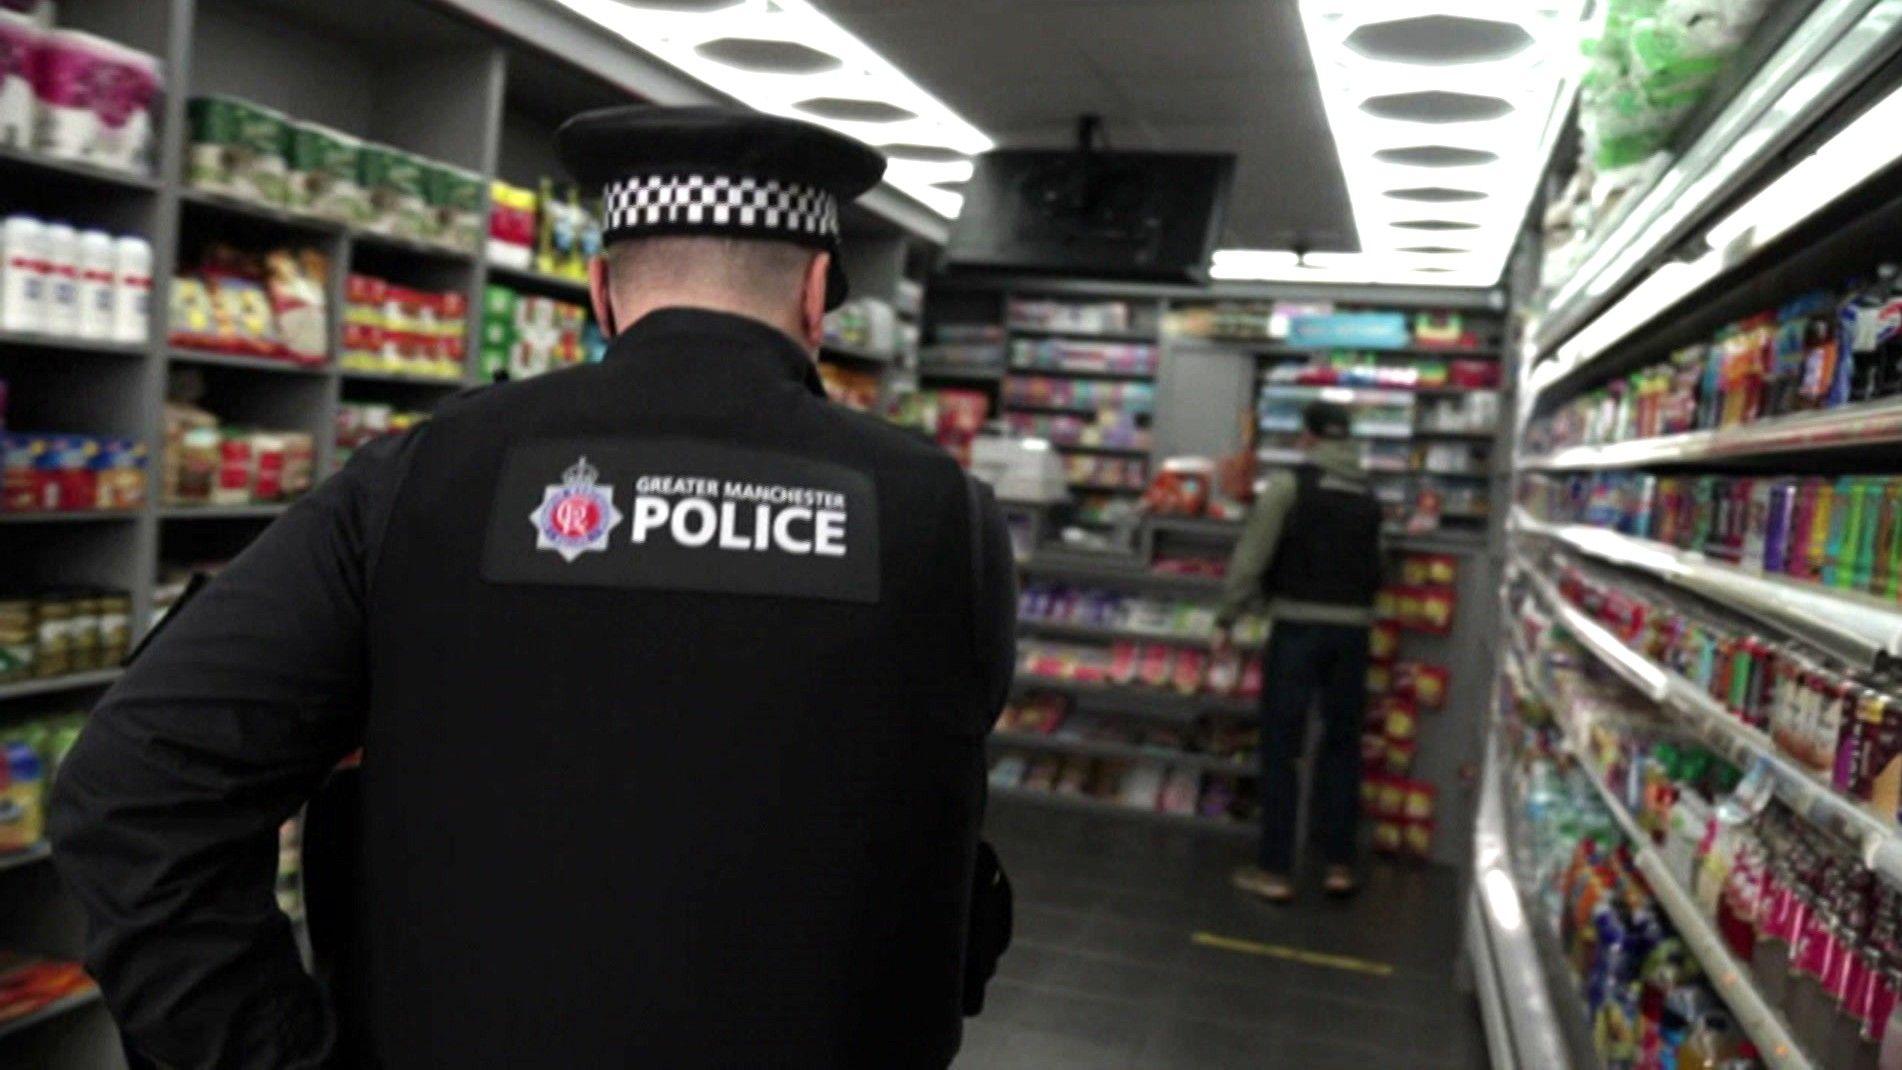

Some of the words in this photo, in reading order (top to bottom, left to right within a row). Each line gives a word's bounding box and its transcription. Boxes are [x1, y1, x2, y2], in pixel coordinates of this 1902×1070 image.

[635, 475, 720, 498] GREATER
[723, 481, 846, 510] MANCHESTER
[631, 495, 848, 557] POLICE
